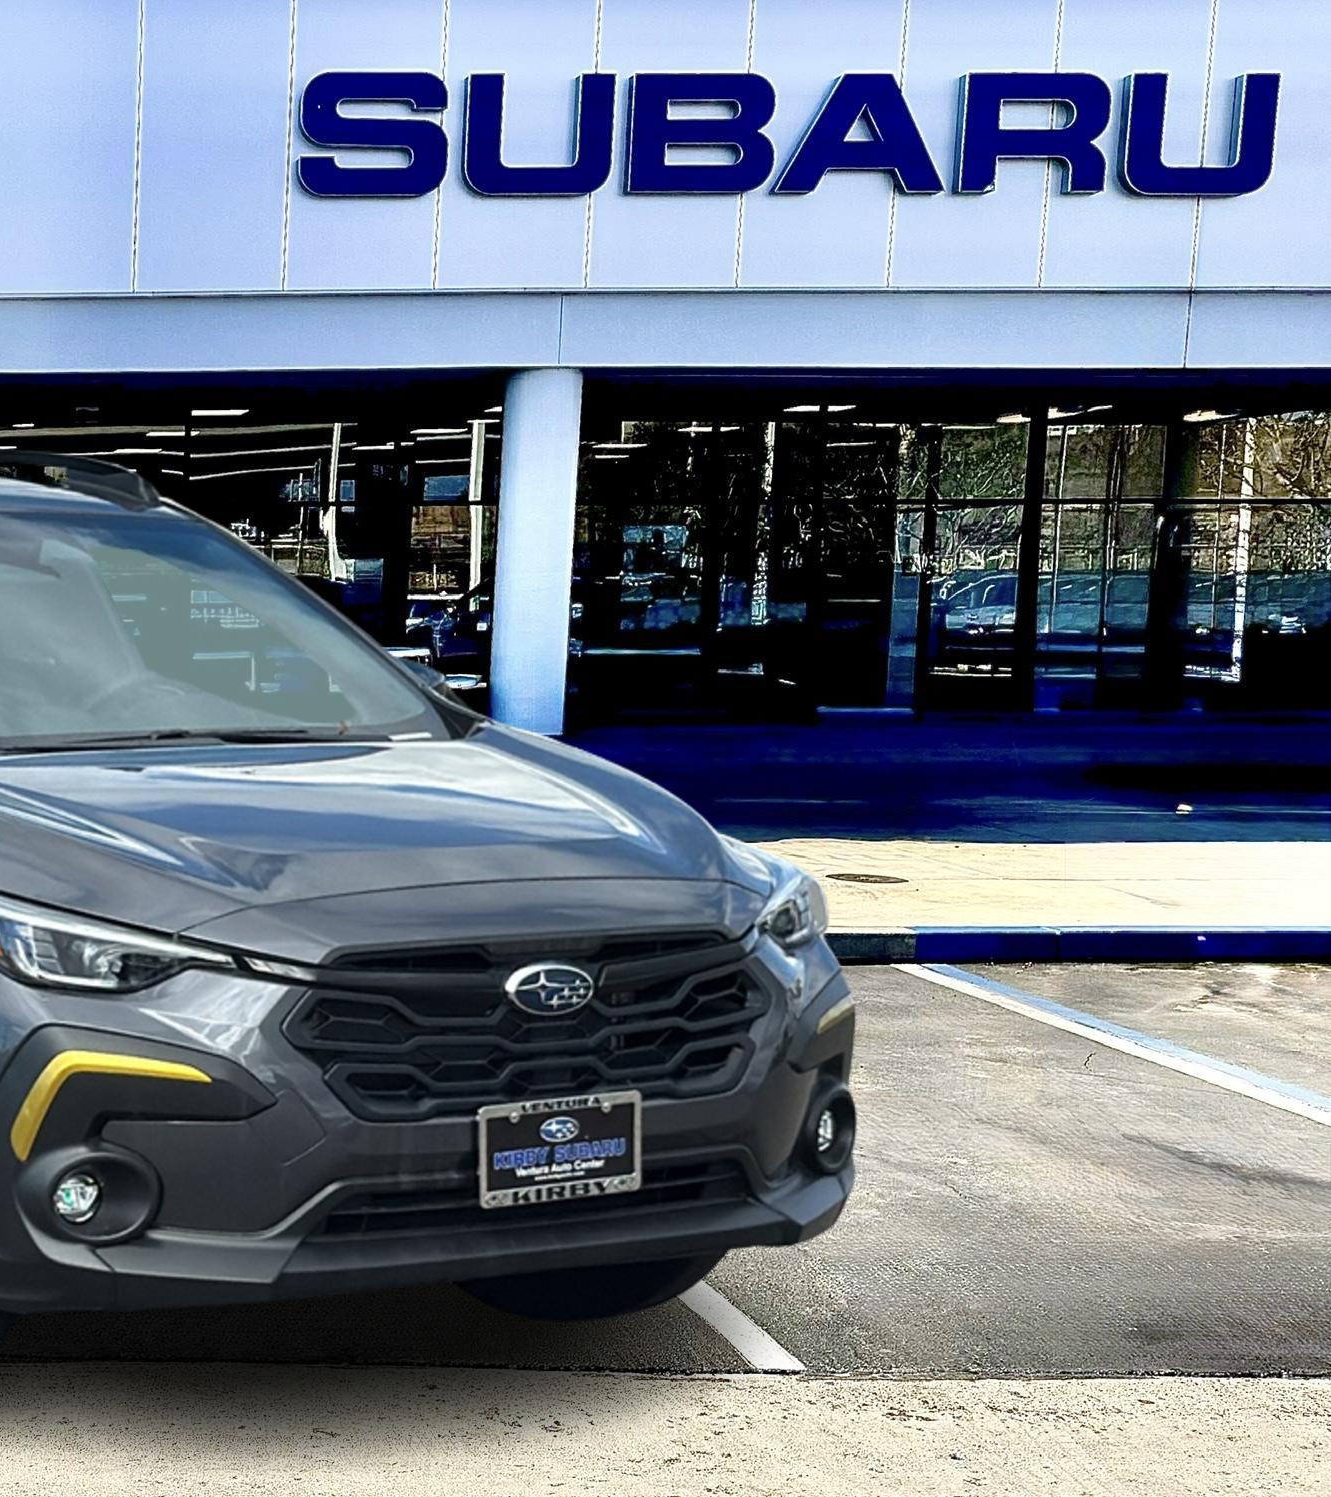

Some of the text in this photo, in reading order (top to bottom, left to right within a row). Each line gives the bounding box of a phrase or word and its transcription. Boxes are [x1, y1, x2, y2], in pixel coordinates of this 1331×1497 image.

[297, 71, 1281, 197] SUBARU
[520, 1097, 601, 1112] VENTURA
[494, 1138, 626, 1169] KIRBY SUBARU
[515, 1165, 549, 1177] Ventura
[551, 1163, 572, 1172] Auto
[574, 1160, 605, 1170] Center
[511, 1182, 609, 1203] KIRBY
